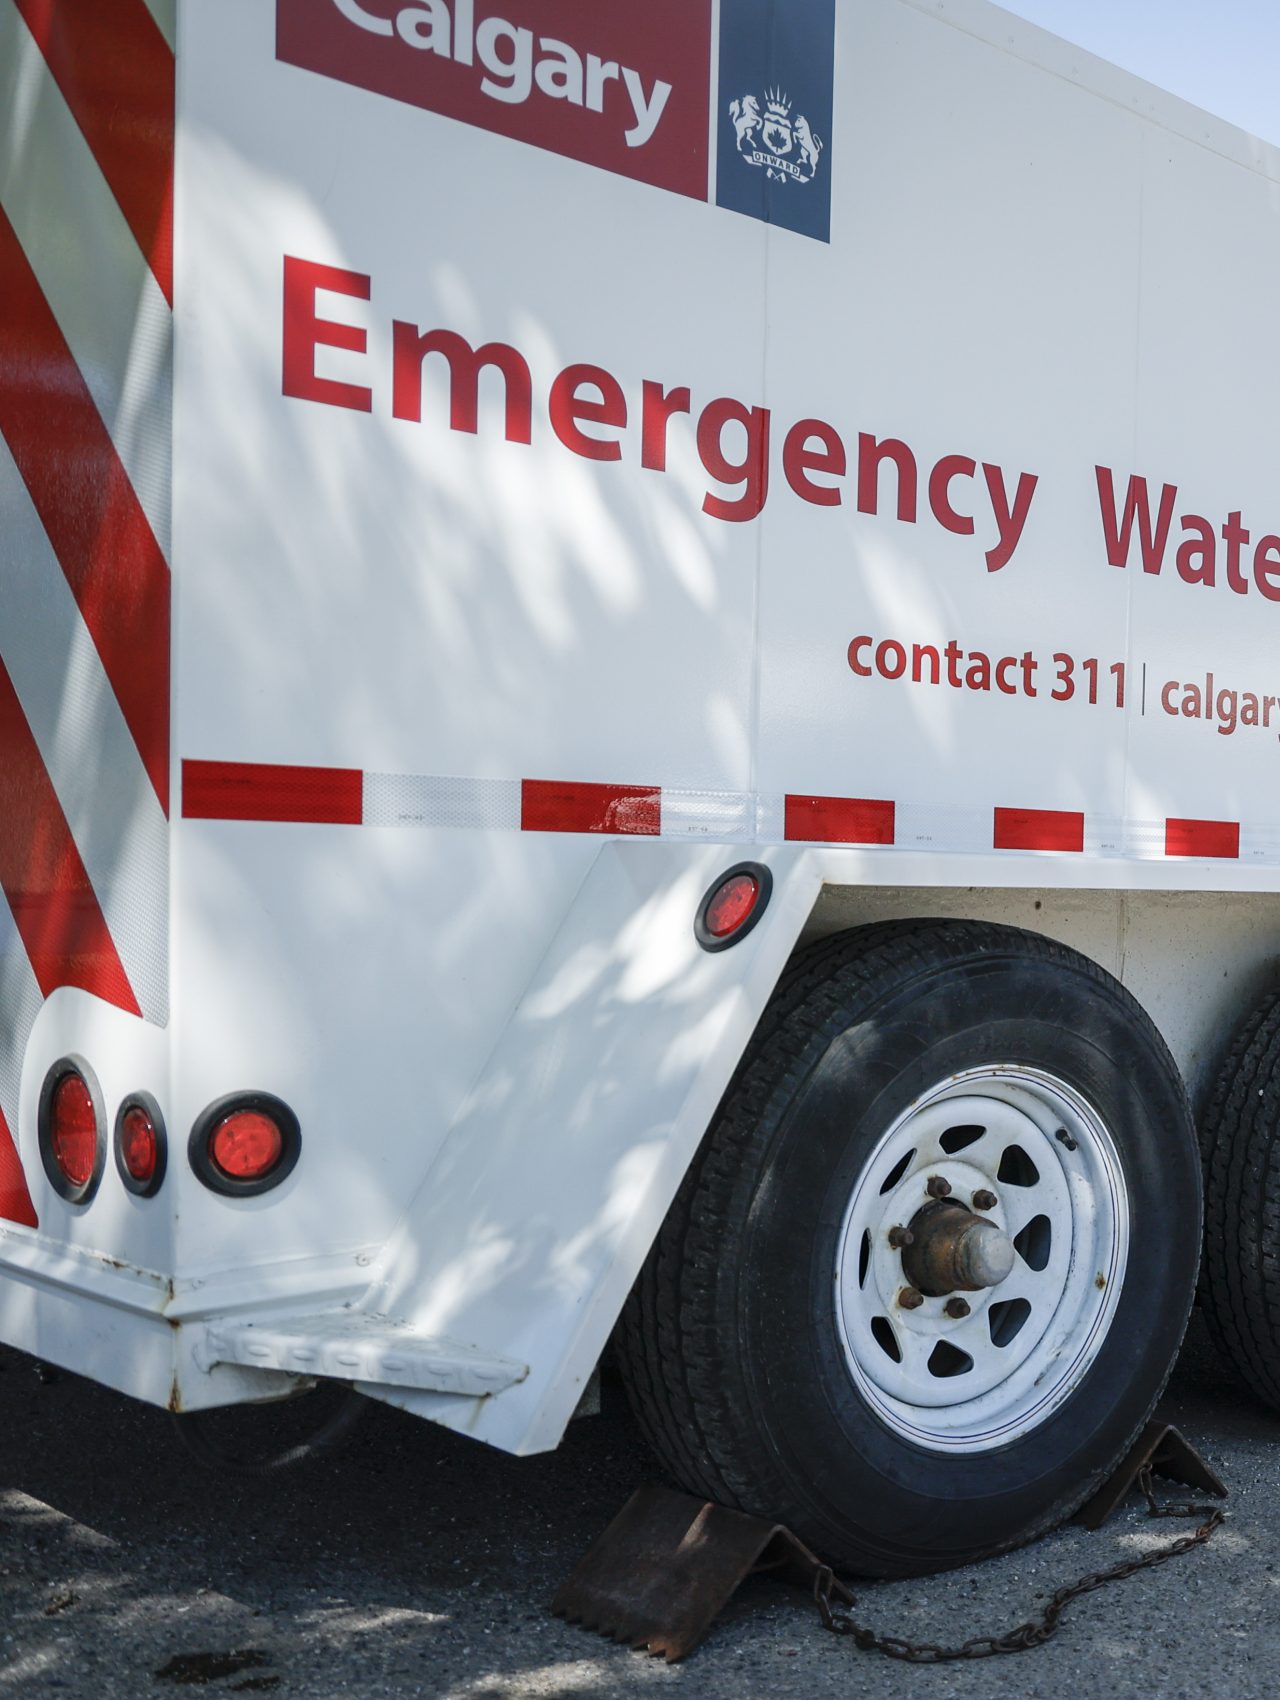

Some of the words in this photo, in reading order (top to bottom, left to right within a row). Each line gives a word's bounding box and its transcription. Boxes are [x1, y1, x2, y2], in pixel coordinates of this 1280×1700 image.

[754, 152, 799, 175] ONWARD
[282, 254, 1038, 572] Emergency
[847, 635, 1038, 698] contact
[1050, 652, 1126, 708] 311
